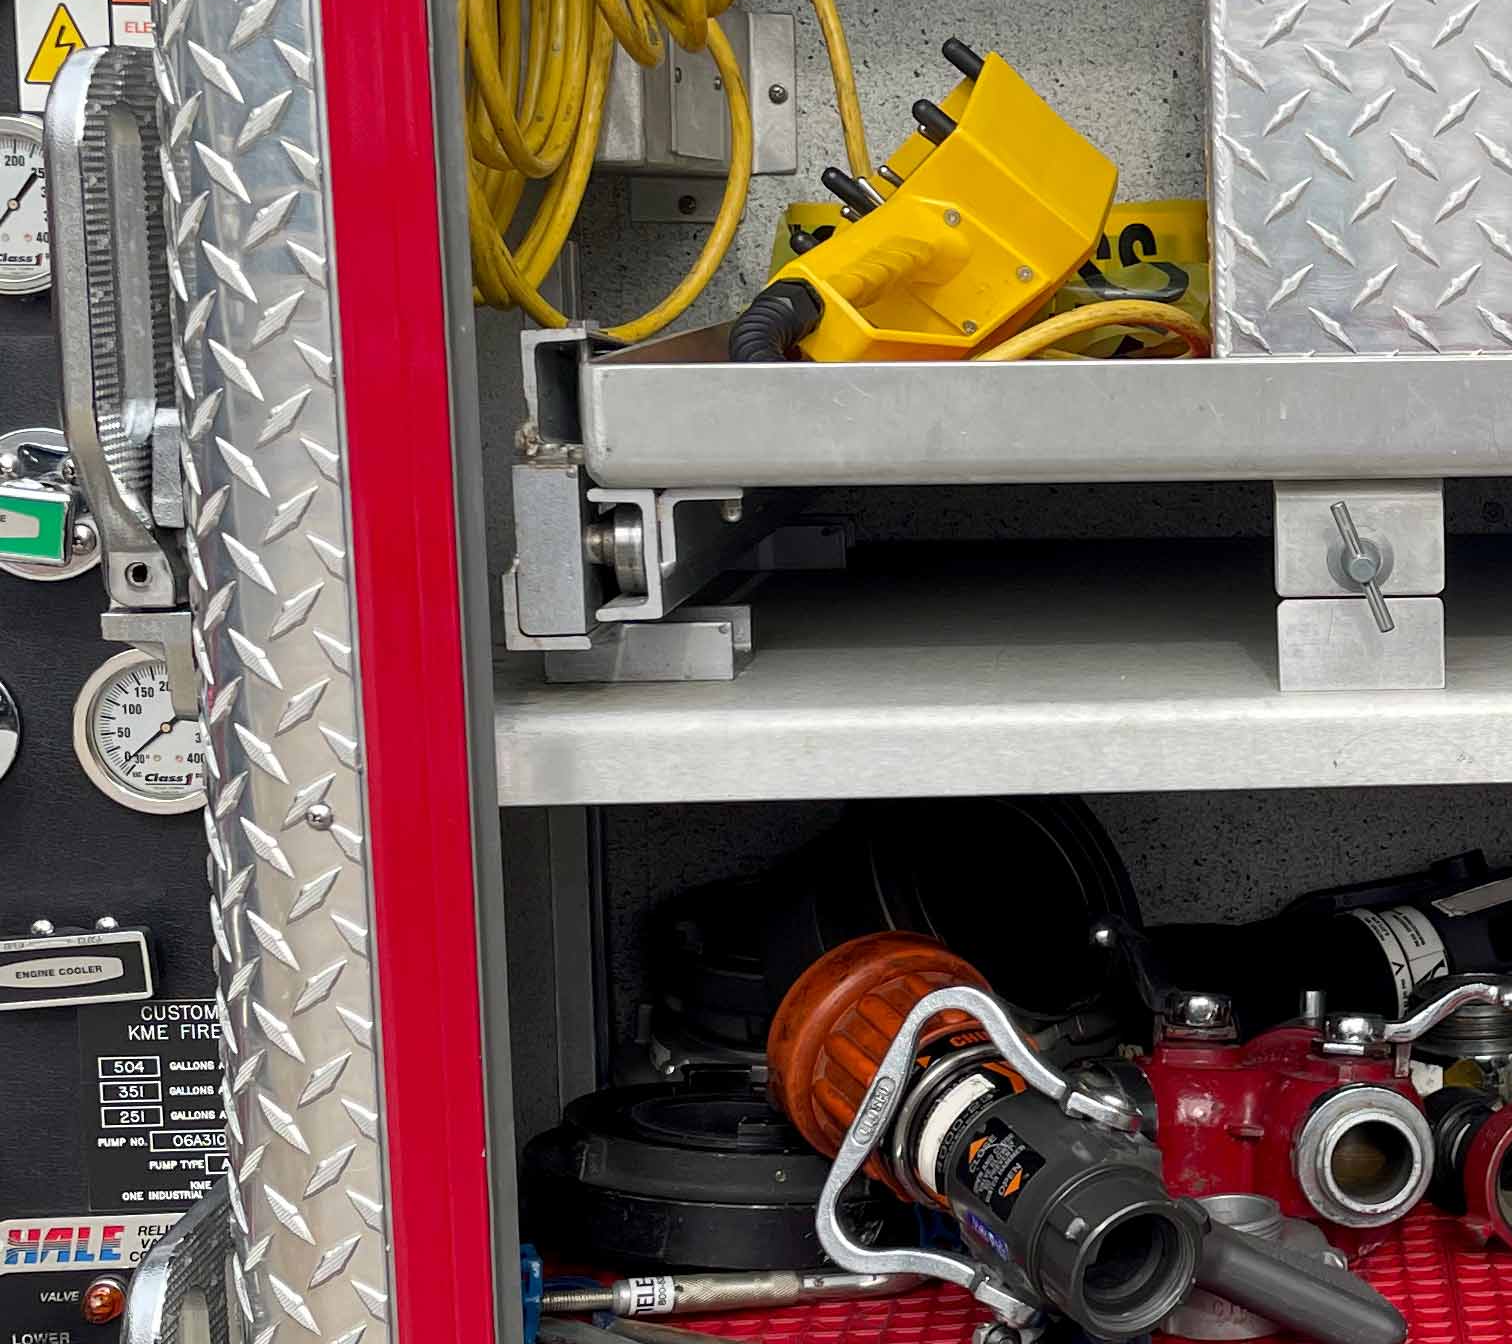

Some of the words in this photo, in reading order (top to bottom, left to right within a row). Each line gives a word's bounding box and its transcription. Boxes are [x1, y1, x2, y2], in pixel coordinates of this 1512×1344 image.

[124, 22, 153, 33] ELE
[5, 155, 25, 167] 200
[134, 686, 155, 698] 150
[122, 703, 142, 714] 100
[117, 727, 131, 738] 50
[15, 969, 56, 980] ENGINE
[58, 965, 103, 976] COOLER
[141, 1004, 219, 1021] CUSTOM
[128, 1024, 169, 1041] KME
[180, 1023, 221, 1040] FIRE
[114, 1061, 145, 1074] 504
[169, 1060, 215, 1071] GALLONS
[118, 1086, 144, 1098] 351
[168, 1086, 214, 1096] GALLONS
[119, 1110, 145, 1124] 251
[170, 1110, 216, 1120] GALLONS
[97, 1137, 127, 1147] PUMP
[130, 1136, 149, 1147] NO.
[149, 1160, 178, 1170] PUMP
[179, 1159, 205, 1169] TYPE
[189, 1180, 213, 1190] KME
[998, 1162, 1023, 1196] OPEN
[122, 1191, 144, 1201] ONE
[148, 1189, 204, 1201] INDUSTRIAL
[4, 1225, 126, 1265] HALE
[39, 1290, 80, 1302] VALVE
